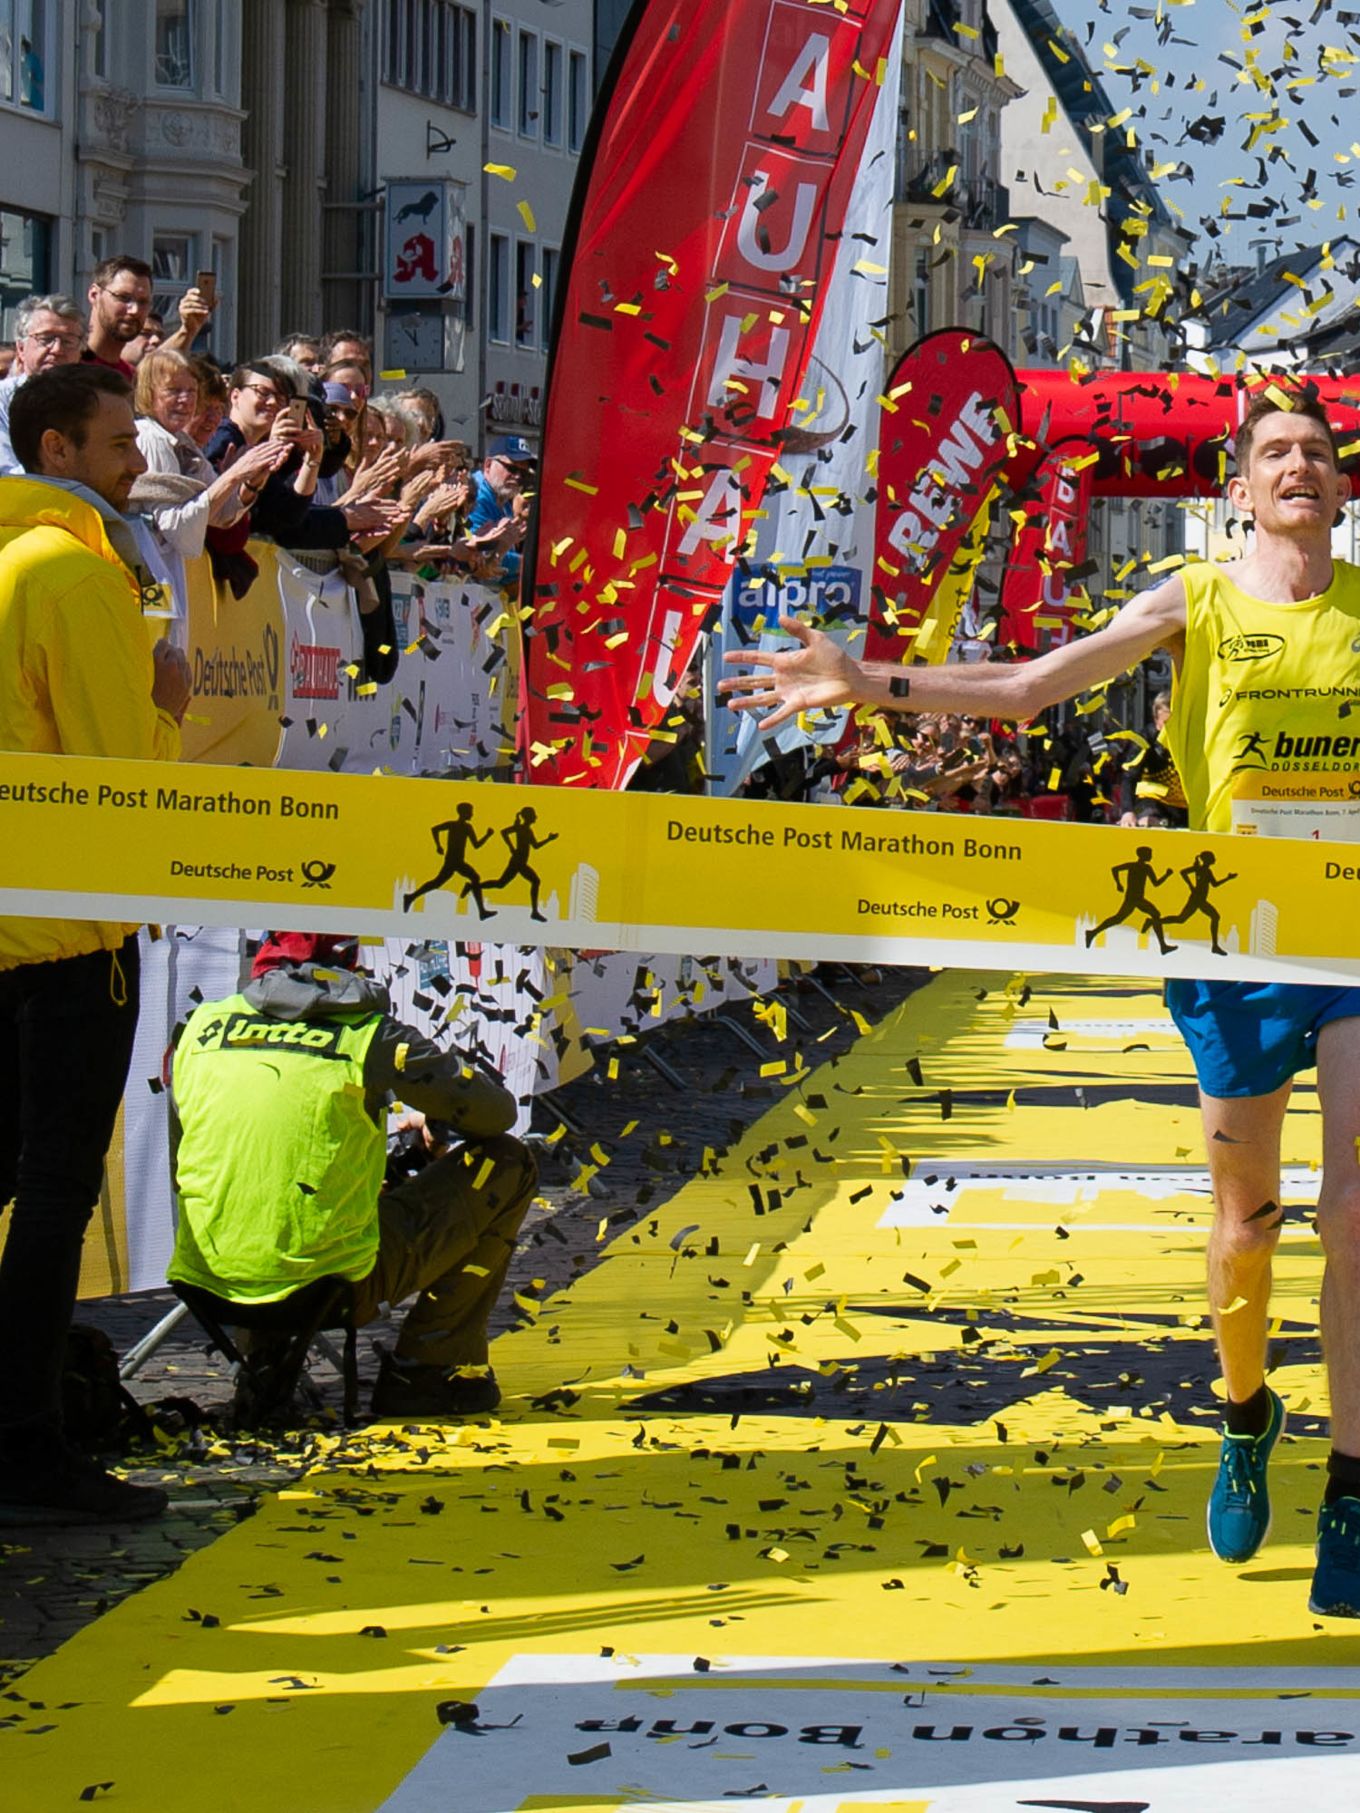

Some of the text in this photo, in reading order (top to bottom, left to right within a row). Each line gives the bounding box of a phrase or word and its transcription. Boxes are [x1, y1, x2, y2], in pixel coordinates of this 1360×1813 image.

[888, 391, 996, 567] REWE
[738, 576, 852, 617] alpro
[193, 646, 247, 697] Deutsche
[0, 781, 339, 820] eutsche Post Marathon Bonn
[1262, 785, 1344, 797] Deutsche Post
[667, 821, 1021, 860] Deutsche Post Marathon Bonn
[170, 860, 294, 883] Deutsche Post
[858, 899, 978, 919] Deutsche Post
[576, 1717, 864, 1747] Bonn
